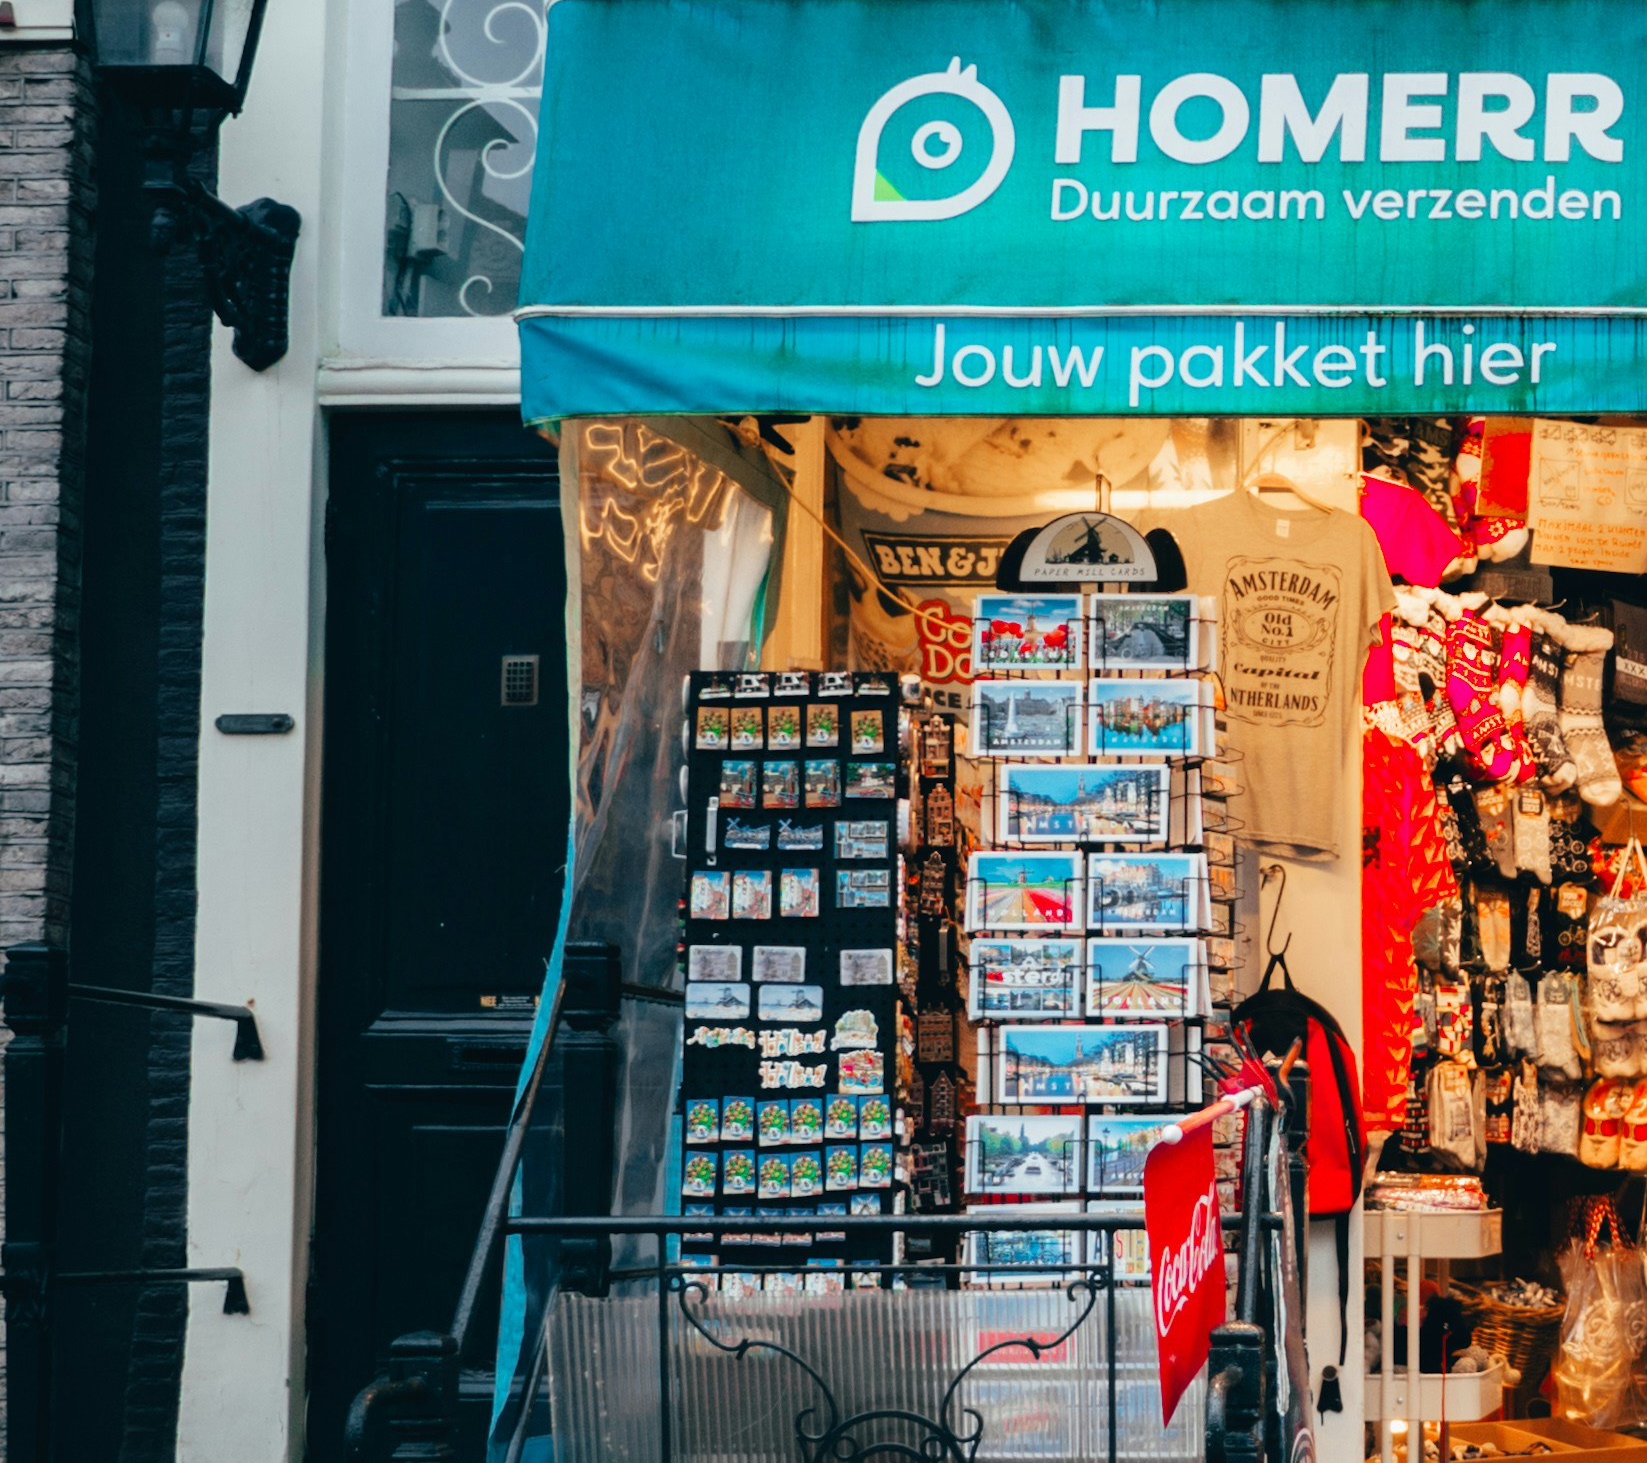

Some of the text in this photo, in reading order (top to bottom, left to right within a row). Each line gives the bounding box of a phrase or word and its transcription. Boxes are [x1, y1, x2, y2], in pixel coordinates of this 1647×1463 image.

[1053, 71, 1625, 165] HOMERR
[1050, 174, 1622, 222] Duurzaam verzenden
[914, 319, 1558, 407] Jouw pakket hier
[1033, 566, 1070, 578] PAPER
[1110, 566, 1147, 578] CARDS
[1228, 570, 1337, 611] AMSTERDAM
[1264, 612, 1293, 626] Old
[1261, 637, 1291, 647] CITY
[1233, 662, 1321, 681] Capital
[1157, 1180, 1219, 1338] Coca-Cola
